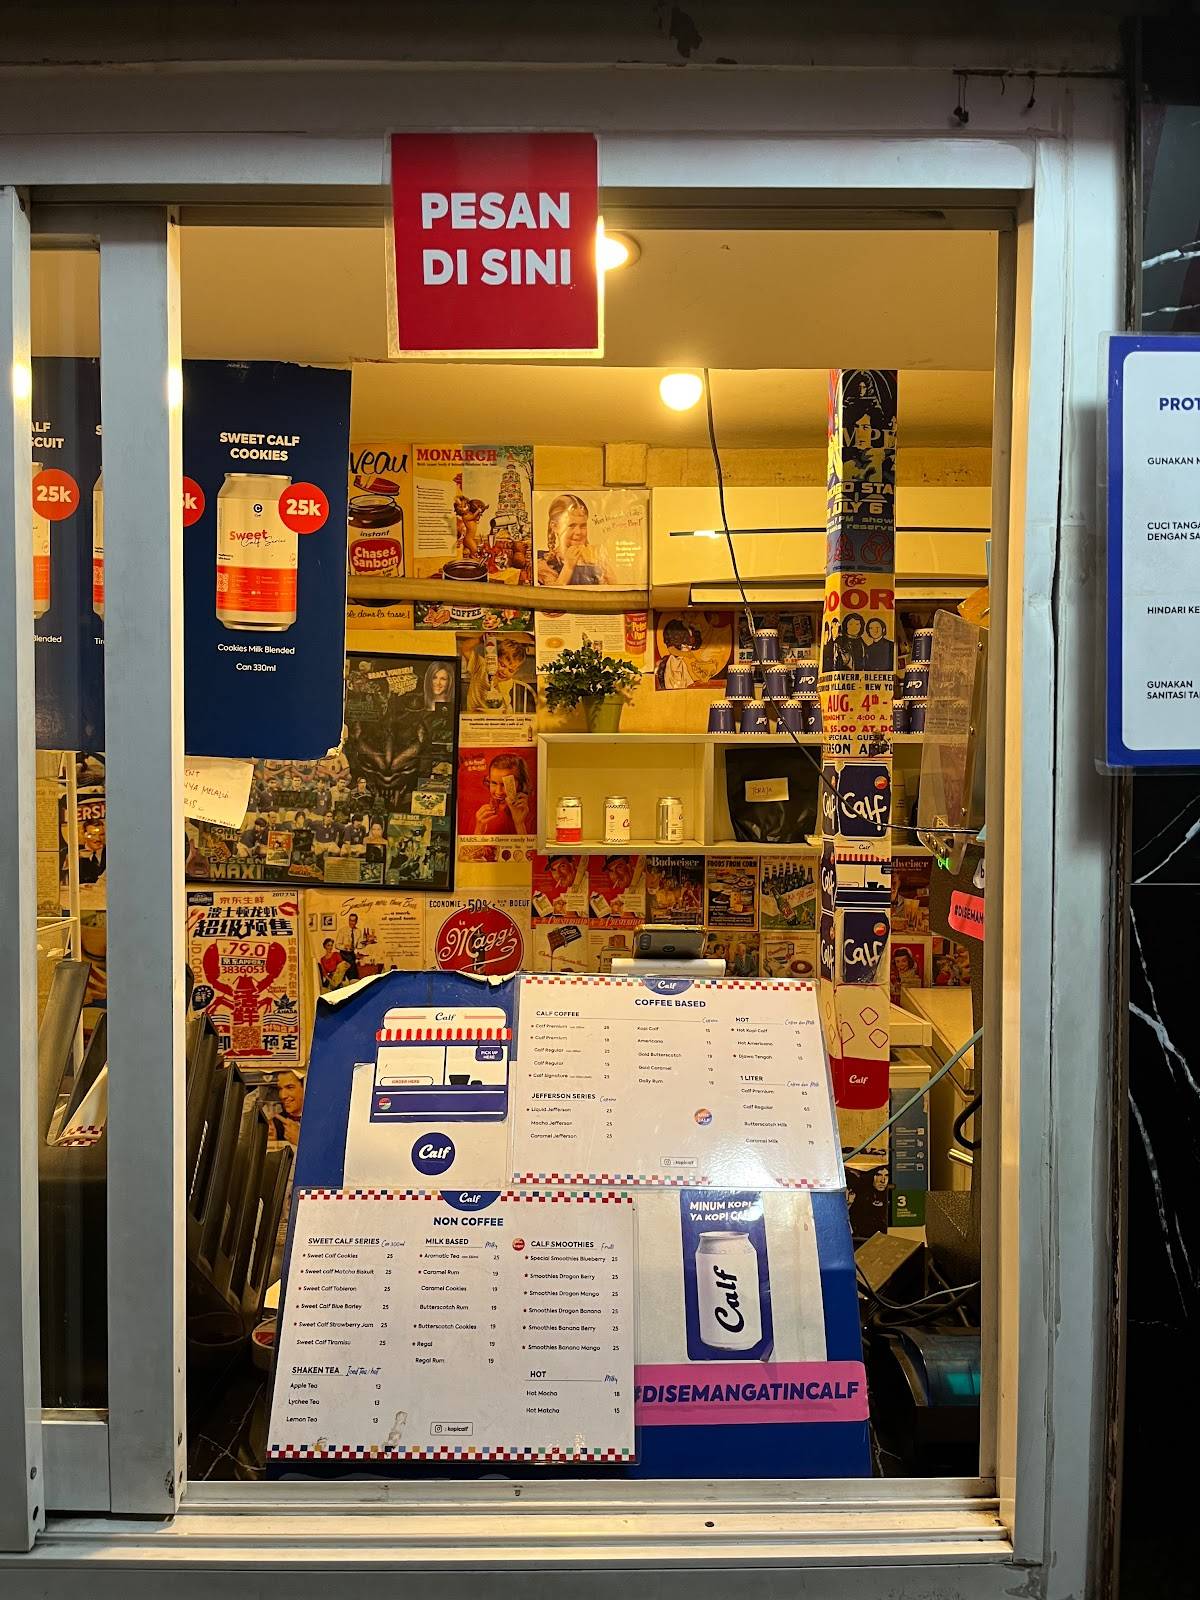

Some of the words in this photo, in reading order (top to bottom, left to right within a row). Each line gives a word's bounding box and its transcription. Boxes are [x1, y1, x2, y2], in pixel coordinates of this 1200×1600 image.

[421, 192, 570, 229] PESAN
[423, 249, 468, 285] DI
[480, 248, 571, 285] SINI
[219, 432, 264, 445] SWEET
[266, 434, 300, 447] CALF
[230, 448, 288, 461] COOKIES
[416, 448, 497, 462] MONARCH
[1148, 457, 1194, 465] GUNAKAN
[36, 485, 72, 502] 25k
[286, 498, 322, 517] 25k
[869, 503, 883, 514] 6
[1147, 522, 1170, 530] CUCI
[229, 529, 268, 541] Sweet
[1147, 533, 1187, 541] DENGAN
[354, 546, 389, 559] Chase
[353, 555, 399, 570] Sanborn
[451, 607, 482, 618] COFFEE
[1147, 606, 1186, 614] HINDARI
[218, 643, 246, 653] Cookies
[248, 644, 263, 653] Milk
[264, 645, 295, 655] Blended
[236, 663, 251, 672] Can
[253, 663, 277, 672] 330ml
[1147, 680, 1193, 688] GUNAKAN
[1147, 691, 1187, 699] SANITASI
[827, 694, 854, 712] AUG.
[841, 792, 887, 831] Calf
[651, 856, 699, 867] Budweiser
[891, 858, 929, 868] dweiser
[429, 900, 461, 908] ECONOMIE
[193, 918, 293, 939] 超级预售
[843, 938, 884, 967] Calf
[221, 966, 265, 974] 3836053
[657, 980, 677, 990] Calf
[635, 998, 673, 1007] COFFEE
[675, 1000, 706, 1008] BASED
[435, 1012, 457, 1021] Calf
[849, 1074, 868, 1085] Calf
[418, 1144, 451, 1160] Calf
[459, 1193, 481, 1204] Calf
[897, 1196, 907, 1206] 3
[690, 1202, 725, 1211] MINUM
[433, 1217, 458, 1226] NON
[461, 1217, 504, 1227] COFFEE
[690, 1213, 702, 1221] YA
[705, 1212, 728, 1221] KOPI
[713, 1265, 745, 1333] Calf
[291, 1366, 324, 1374] SHAKEN
[290, 1382, 307, 1390] Apple
[447, 1425, 468, 1433] kopicalf
